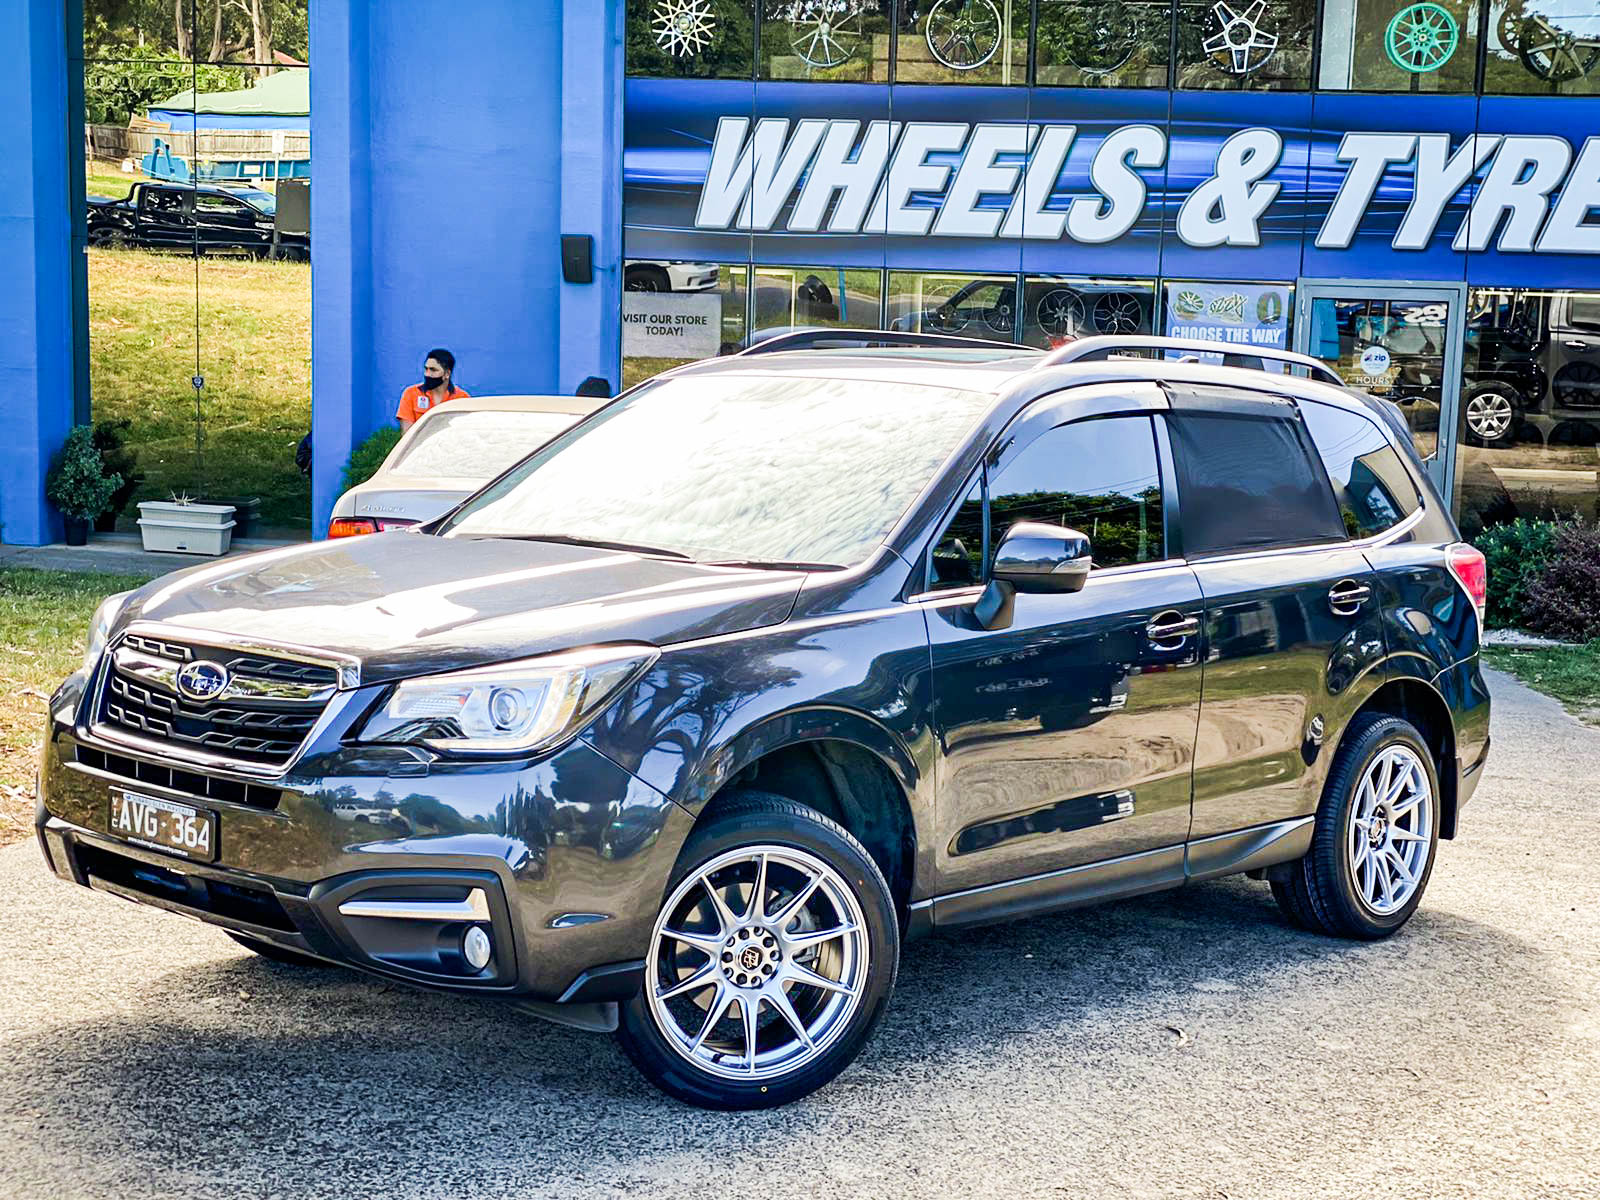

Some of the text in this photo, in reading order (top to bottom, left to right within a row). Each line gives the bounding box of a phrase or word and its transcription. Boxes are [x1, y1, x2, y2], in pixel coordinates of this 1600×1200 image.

[694, 115, 1600, 253] WHEELS & TYRE
[623, 313, 707, 325] VISIT OUR STORE
[646, 326, 683, 336] TODAY!
[1171, 326, 1281, 344] CHOOSE THE WAY
[1374, 353, 1387, 362] zip
[1356, 375, 1390, 385] HOURS
[119, 800, 158, 838] AVG
[170, 813, 210, 852] 364
